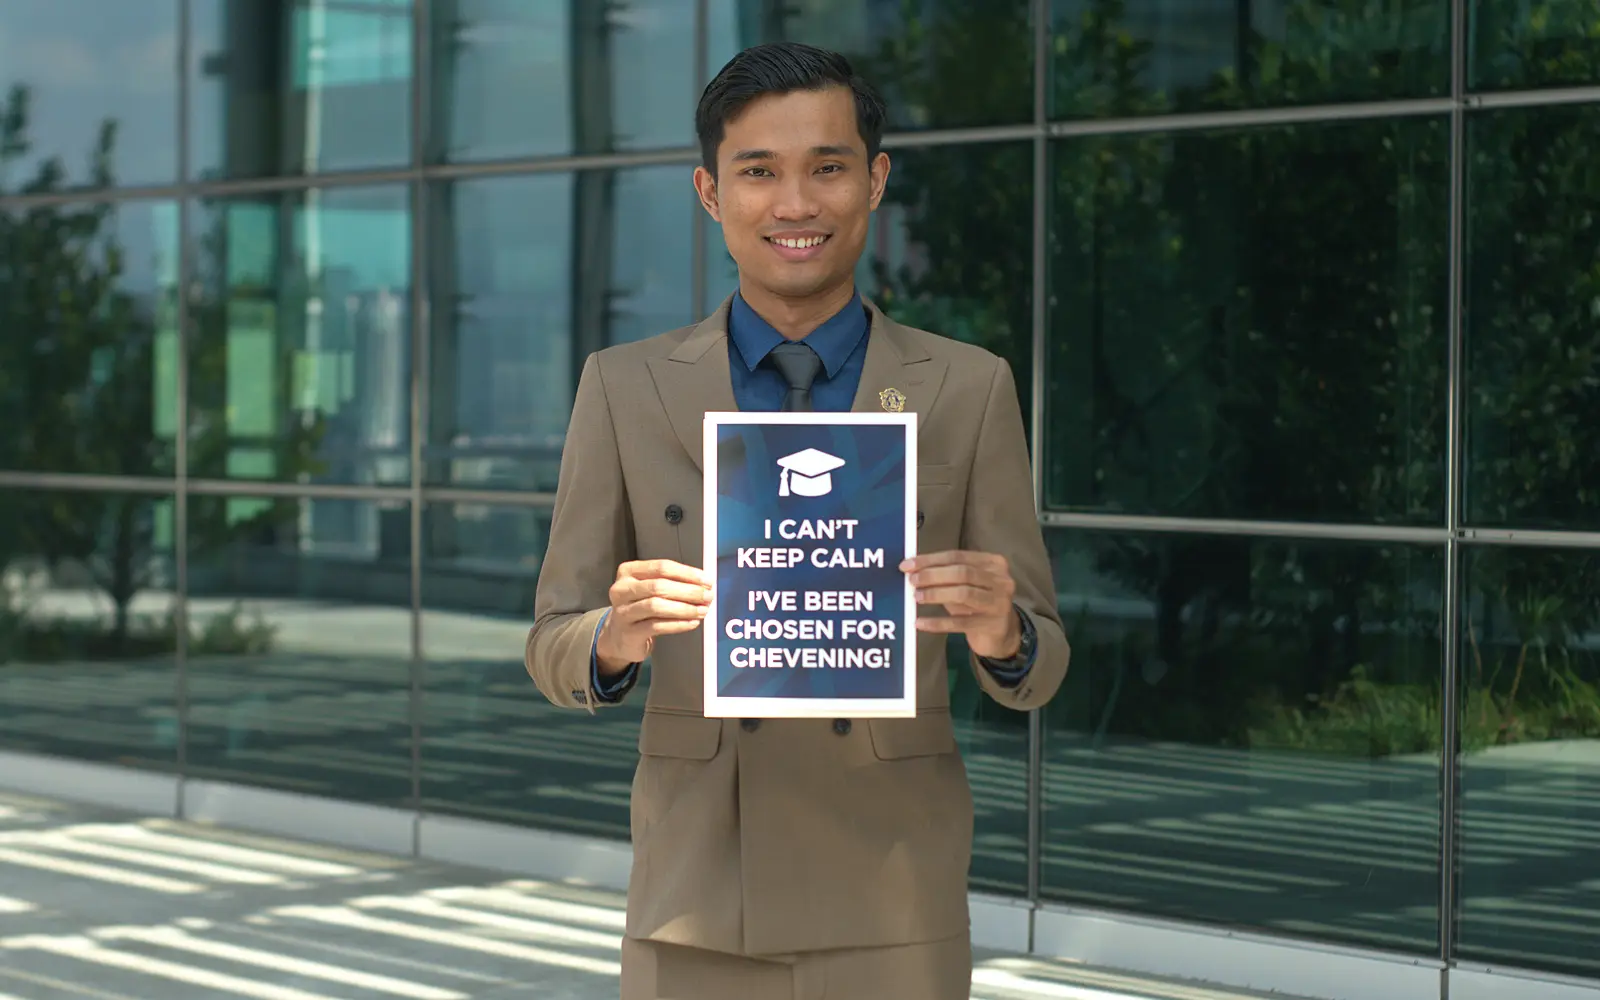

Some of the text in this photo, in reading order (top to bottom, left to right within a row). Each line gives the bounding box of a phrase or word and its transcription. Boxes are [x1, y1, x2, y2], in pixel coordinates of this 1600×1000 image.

[764, 519, 859, 540] I CAN'T
[737, 547, 884, 568] KEEP CALM
[748, 590, 873, 611] I'VE BEEN
[725, 618, 896, 640] CHOSEN FOR
[729, 646, 891, 669] CHEVENING!
